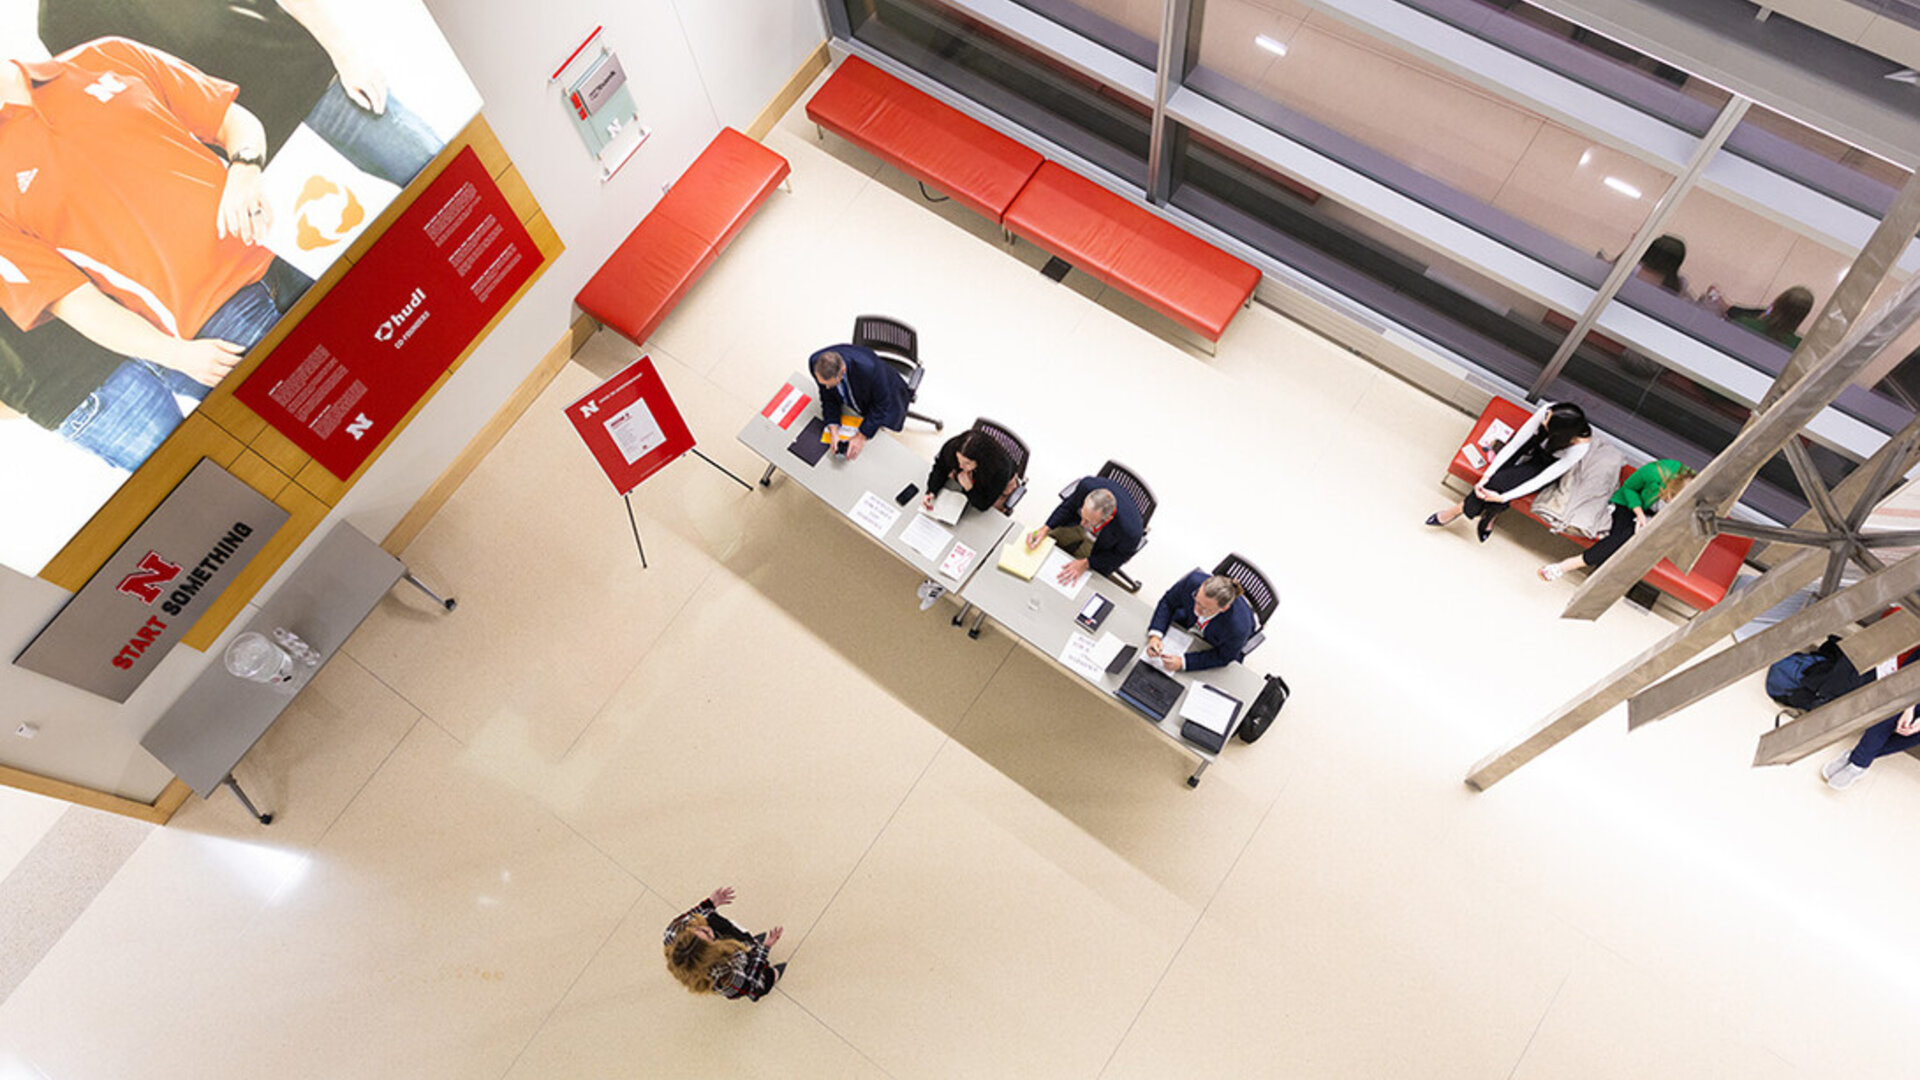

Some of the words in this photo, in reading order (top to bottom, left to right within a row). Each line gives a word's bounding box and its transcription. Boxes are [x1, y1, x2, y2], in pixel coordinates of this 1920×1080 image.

[390, 287, 427, 327] hudl
[345, 412, 374, 441] N
[579, 399, 600, 419] N
[111, 615, 168, 670] START
[161, 521, 254, 617] SOMETHING
[116, 550, 184, 606] N
